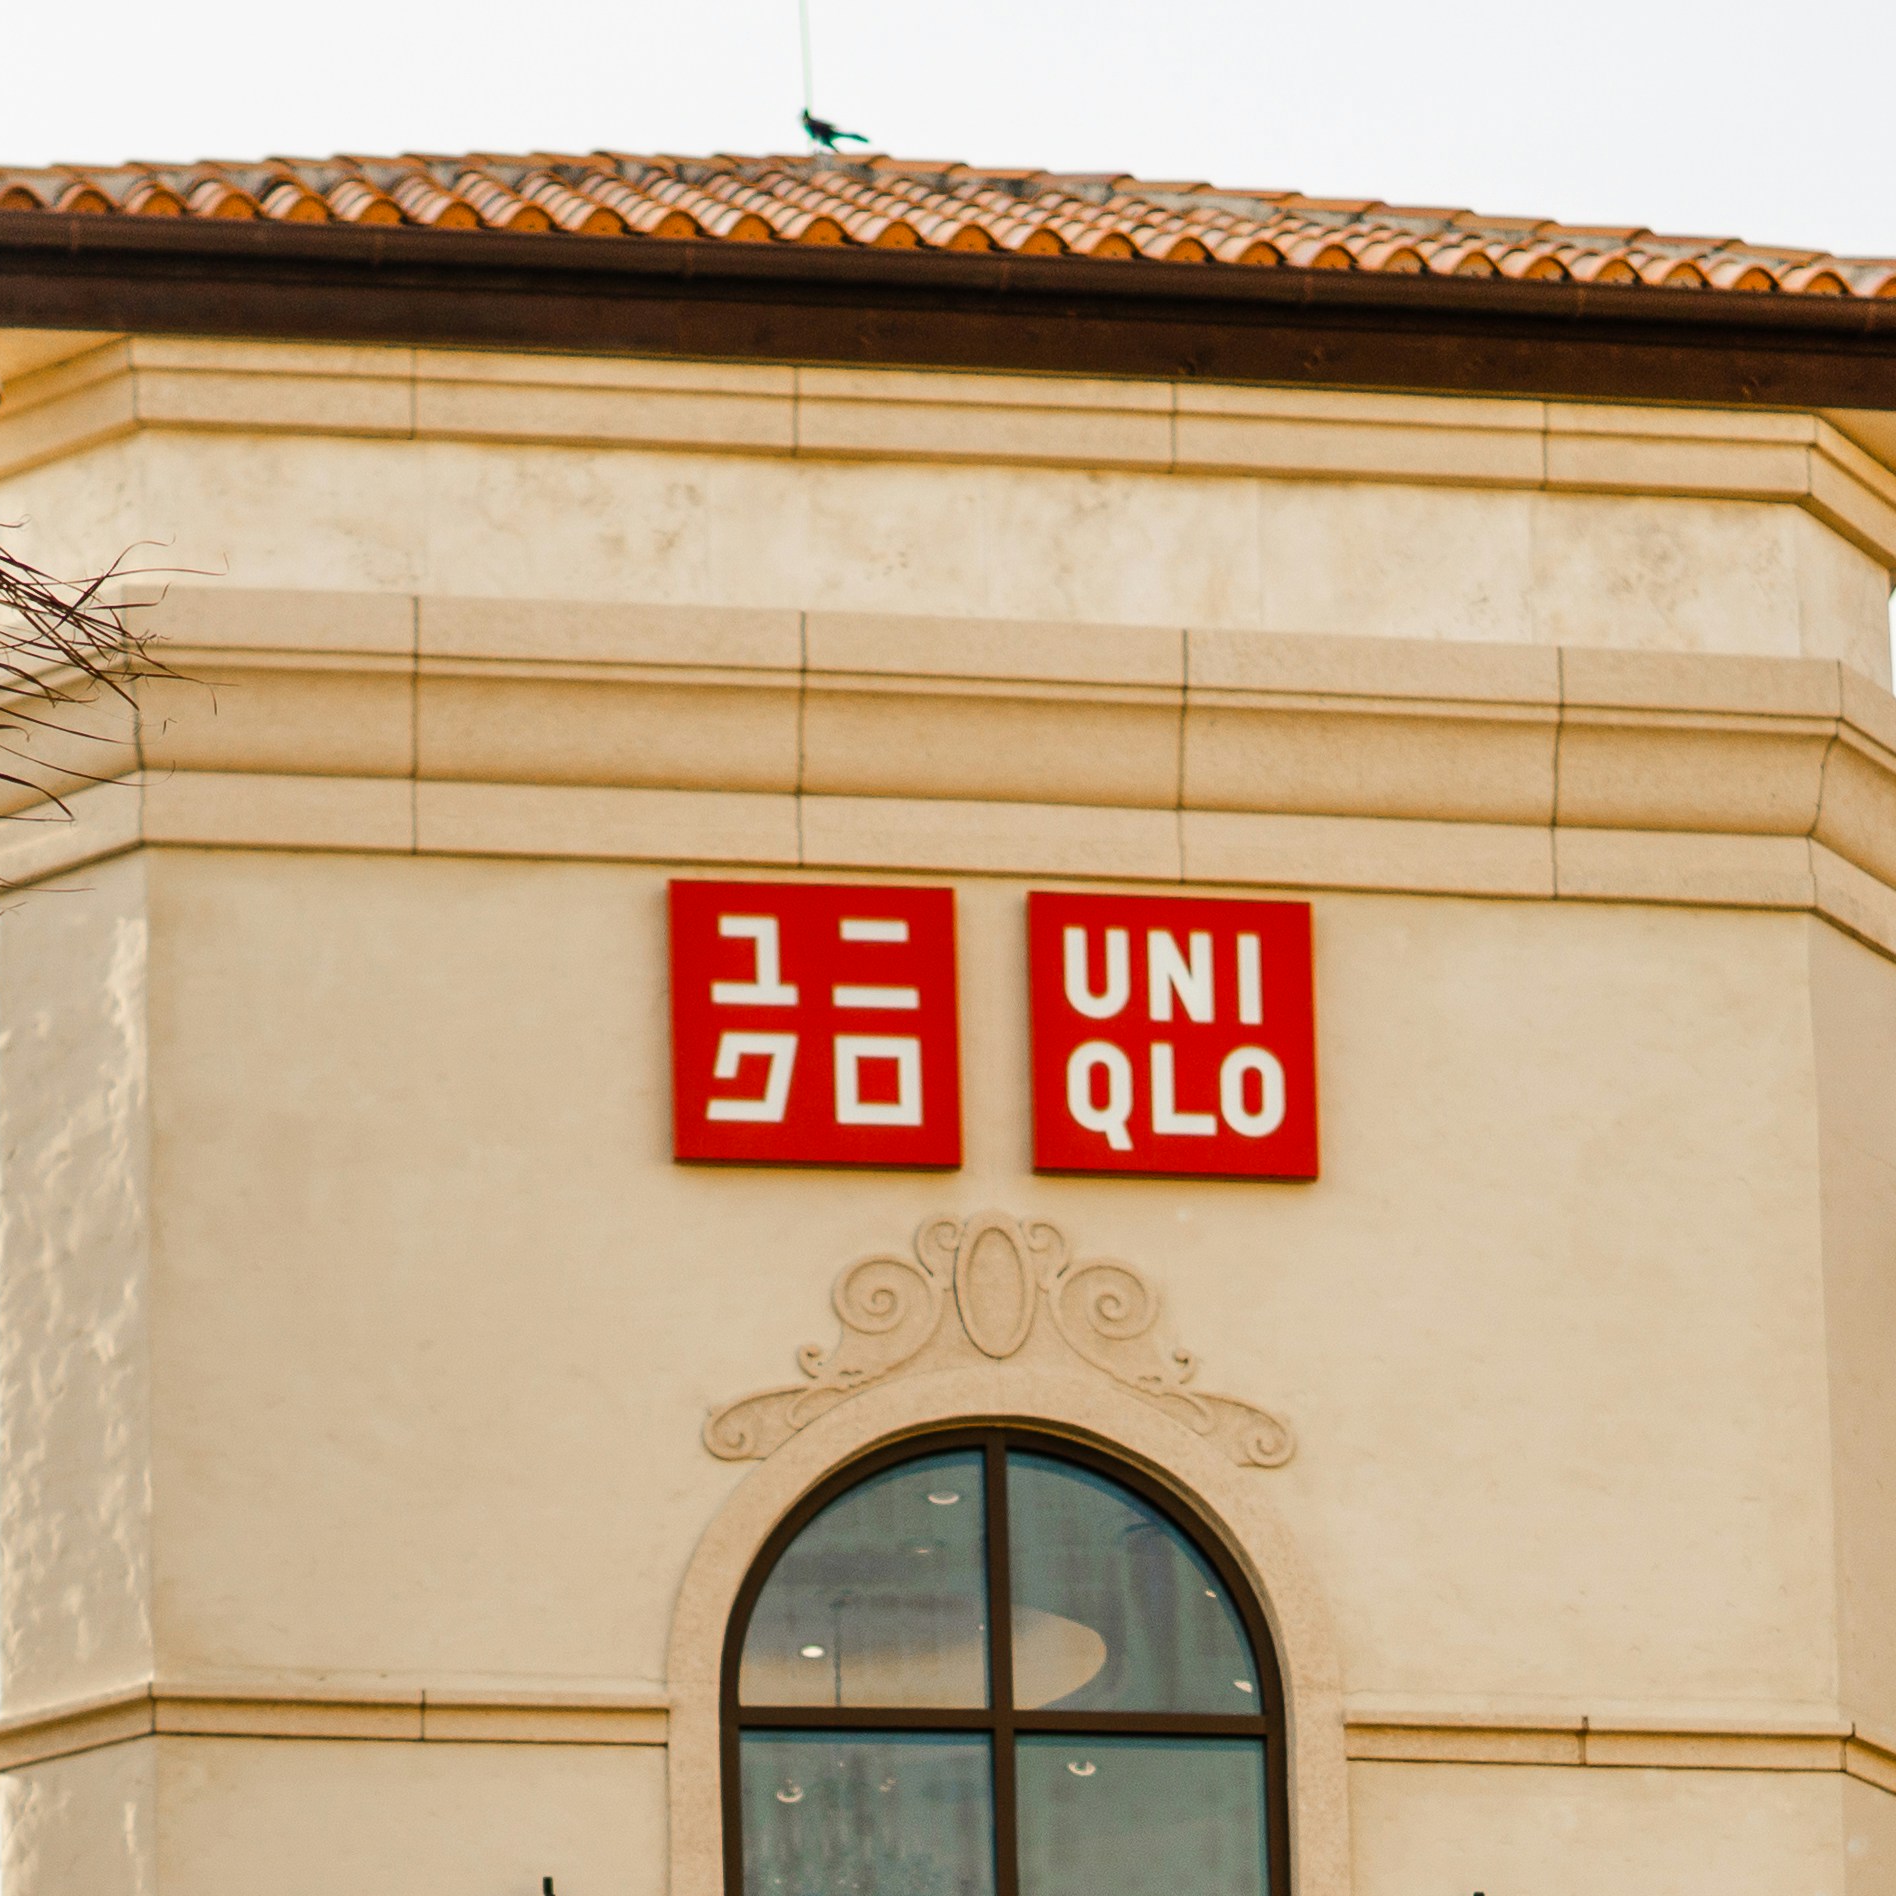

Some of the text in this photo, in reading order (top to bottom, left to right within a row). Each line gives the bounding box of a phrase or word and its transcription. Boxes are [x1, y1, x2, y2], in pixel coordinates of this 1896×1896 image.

[710, 914, 921, 1009] ユニ
[1063, 925, 1263, 1025] UNI
[1065, 1039, 1286, 1151] QLO
